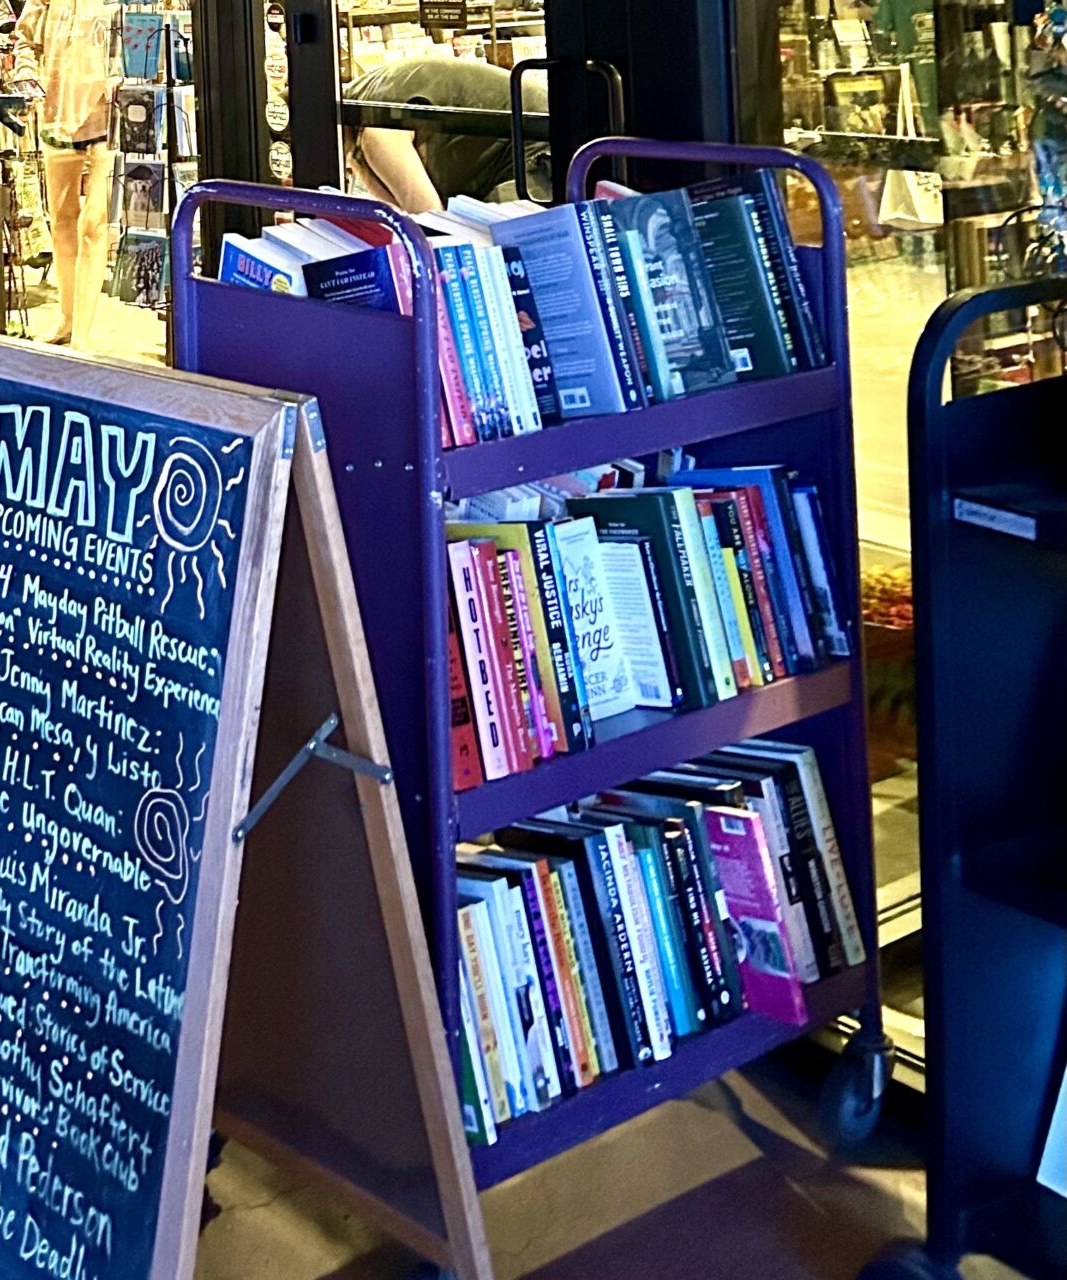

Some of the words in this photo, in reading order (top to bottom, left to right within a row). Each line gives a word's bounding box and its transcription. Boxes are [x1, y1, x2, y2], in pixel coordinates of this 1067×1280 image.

[580, 211, 601, 270] WINSPEAR
[601, 214, 617, 243] SMALL
[608, 247, 625, 274] TOWN
[236, 255, 273, 287] BILLY
[444, 253, 457, 282] PEACH
[451, 282, 466, 320] BLOSSOM
[460, 322, 475, 355] SPRING
[463, 249, 476, 277] PEACH
[470, 279, 486, 318] BLOSSOM
[479, 319, 493, 351] SPRING
[616, 275, 631, 298] SINS
[617, 338, 634, 386] WEAPON
[726, 503, 737, 524] YOU
[731, 526, 742, 546] ARE
[84, 533, 154, 584] EVENTS
[534, 530, 548, 570] VIRAL
[542, 572, 563, 630] JUSTICE
[736, 549, 748, 570] NOT
[741, 572, 755, 605] ALONE
[22, 574, 89, 641] Mayday
[93, 596, 145, 652] Pitbull
[499, 561, 521, 651] BREATHING
[516, 658, 529, 694] FIRE
[27, 616, 84, 660] Virtual
[85, 634, 140, 702] Reality
[462, 567, 500, 748] HOTBED
[505, 663, 514, 680] The
[551, 642, 570, 694] BENJAMIN
[22, 801, 153, 893] Ungovernable
[18, 899, 68, 965] Story
[71, 937, 93, 963] of
[99, 949, 130, 993] the
[29, 862, 114, 938] Miranda
[121, 914, 148, 964] Jr.
[599, 844, 617, 908] JACINDA
[614, 914, 633, 973] ARDERN
[686, 887, 696, 910] FIND
[692, 911, 701, 926] ME
[0, 923, 103, 1028] Transforming
[104, 994, 172, 1054] America
[33, 1003, 89, 1064] Stories
[90, 1048, 109, 1072] of
[108, 1047, 173, 1118] Service
[47, 1058, 154, 1175] Schaffert
[54, 1102, 99, 1167] Book
[100, 1143, 140, 1193] Club
[15, 1130, 114, 1260] Pederson
